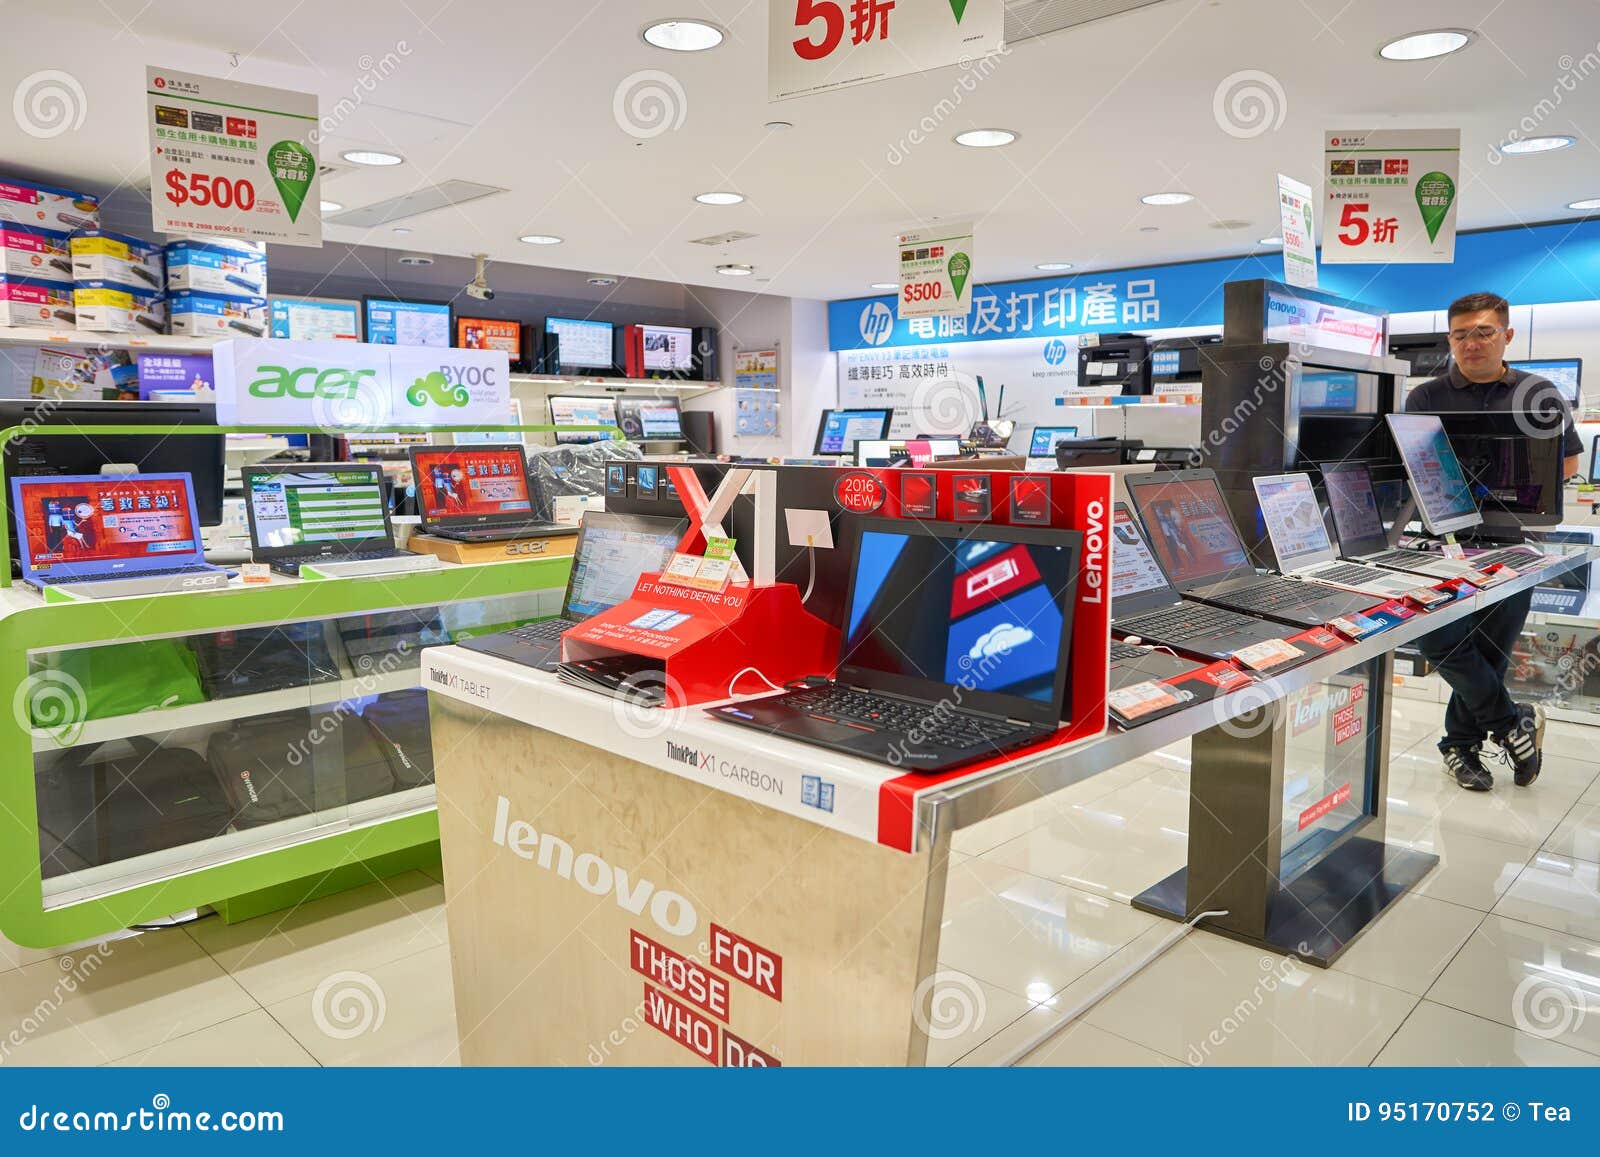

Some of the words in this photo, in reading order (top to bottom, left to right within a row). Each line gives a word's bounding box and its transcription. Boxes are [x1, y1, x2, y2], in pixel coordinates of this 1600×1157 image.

[165, 168, 255, 211] $500
[1338, 203, 1399, 246] 5折
[904, 281, 941, 303] $500
[860, 302, 893, 345] hp
[1044, 339, 1066, 365] hp
[249, 366, 376, 399] acer
[440, 366, 496, 386] BYOC
[899, 362, 948, 379] 高效時尚
[845, 479, 874, 492] 2016
[845, 494, 874, 507] NEW
[505, 541, 549, 555] acer
[1083, 501, 1104, 604] Lenovo
[183, 574, 225, 588] acer
[638, 582, 654, 592] LET
[653, 584, 689, 598] NOTHING
[690, 591, 722, 605] DEFINE
[723, 596, 743, 608] YOU
[460, 679, 490, 699] TABLET
[666, 741, 698, 767] ThinkPad
[700, 752, 715, 773] X1
[719, 761, 783, 795] CARBON
[492, 795, 697, 936] lenovo
[715, 931, 775, 994] FOR
[634, 936, 725, 1016] THOSE
[650, 991, 712, 1056] WHO
